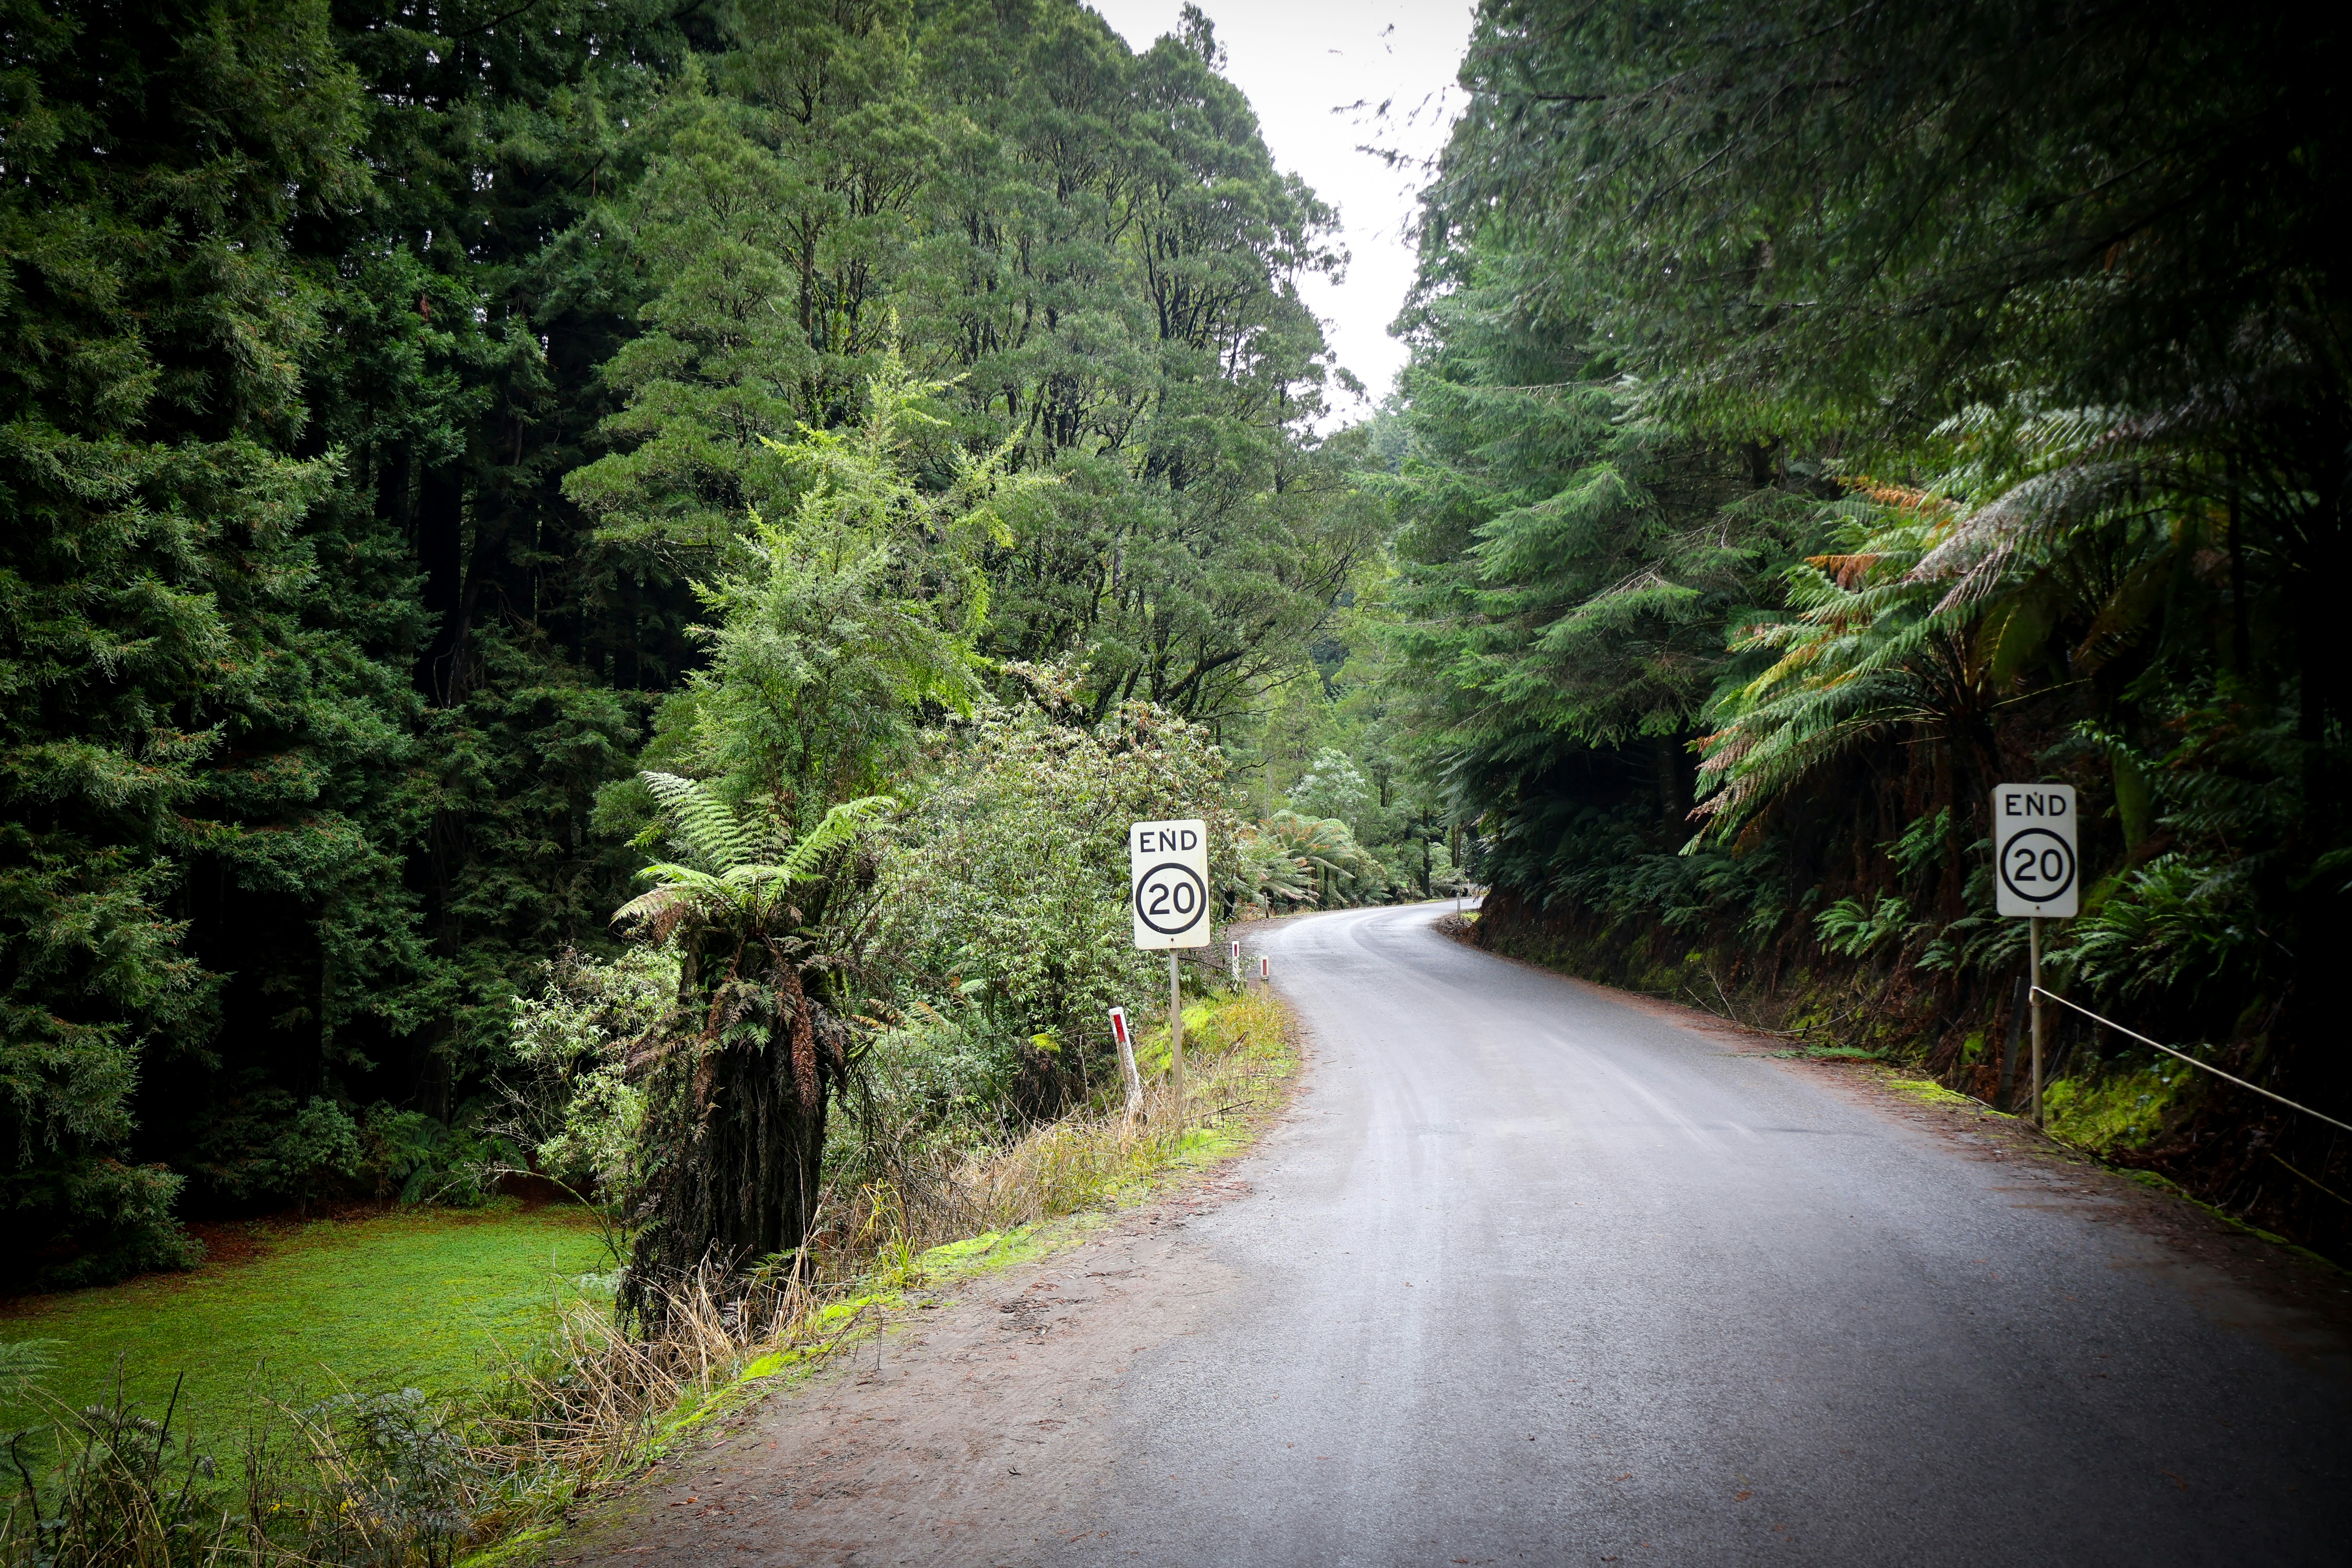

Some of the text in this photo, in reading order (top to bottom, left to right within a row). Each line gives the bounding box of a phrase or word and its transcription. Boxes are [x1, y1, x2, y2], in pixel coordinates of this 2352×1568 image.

[2006, 794, 2066, 816] END
[1140, 830, 1197, 853] END
[2014, 848, 2063, 882] 20
[1149, 882, 1194, 915] 20
